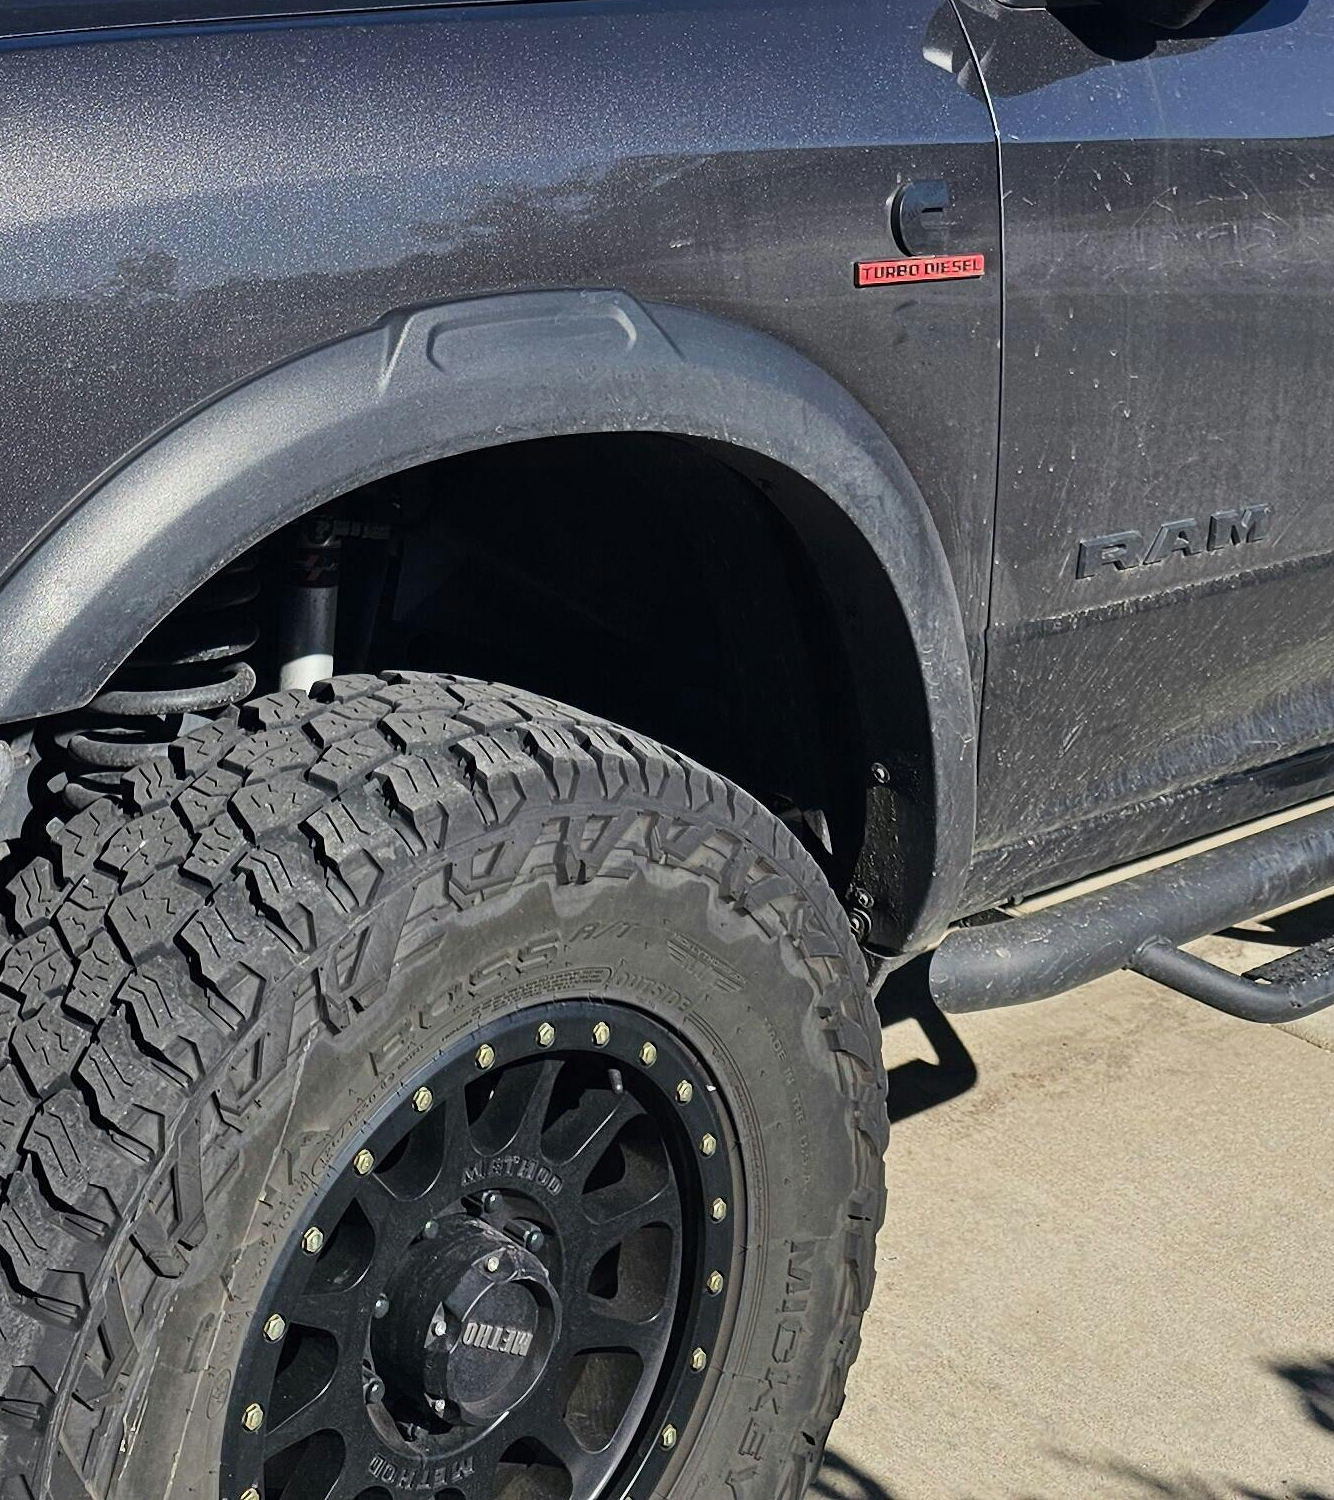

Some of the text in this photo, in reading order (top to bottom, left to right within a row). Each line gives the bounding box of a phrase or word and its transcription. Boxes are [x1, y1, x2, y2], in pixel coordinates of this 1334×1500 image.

[861, 258, 983, 281] TURBO DIESEL
[1075, 503, 1272, 580] RAM
[461, 1155, 564, 1197] METHOD
[462, 1322, 534, 1358] METHO
[369, 1454, 475, 1491] METHOD
